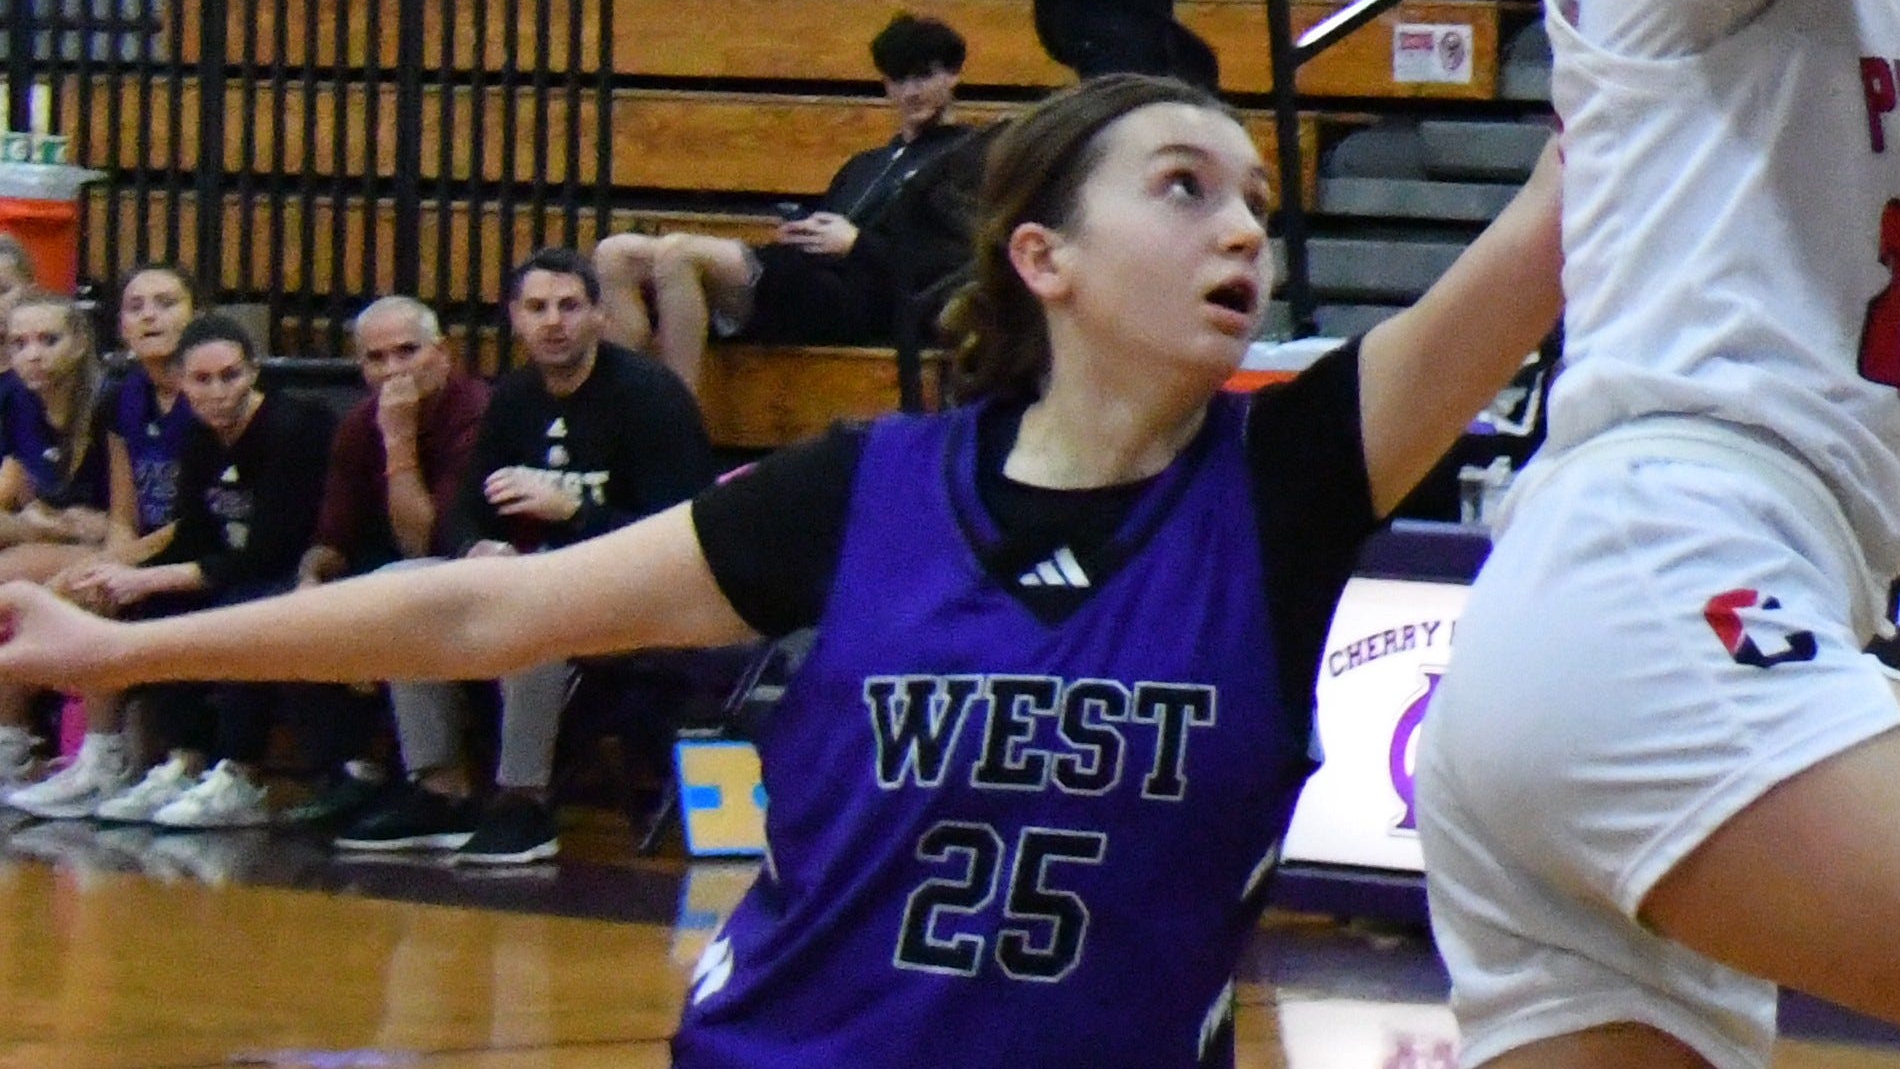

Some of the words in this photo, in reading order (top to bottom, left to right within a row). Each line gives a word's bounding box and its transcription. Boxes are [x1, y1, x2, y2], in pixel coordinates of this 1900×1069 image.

[1328, 618, 1442, 678] CHERRY
[862, 674, 1218, 801] WEST
[892, 820, 1108, 983] 25
